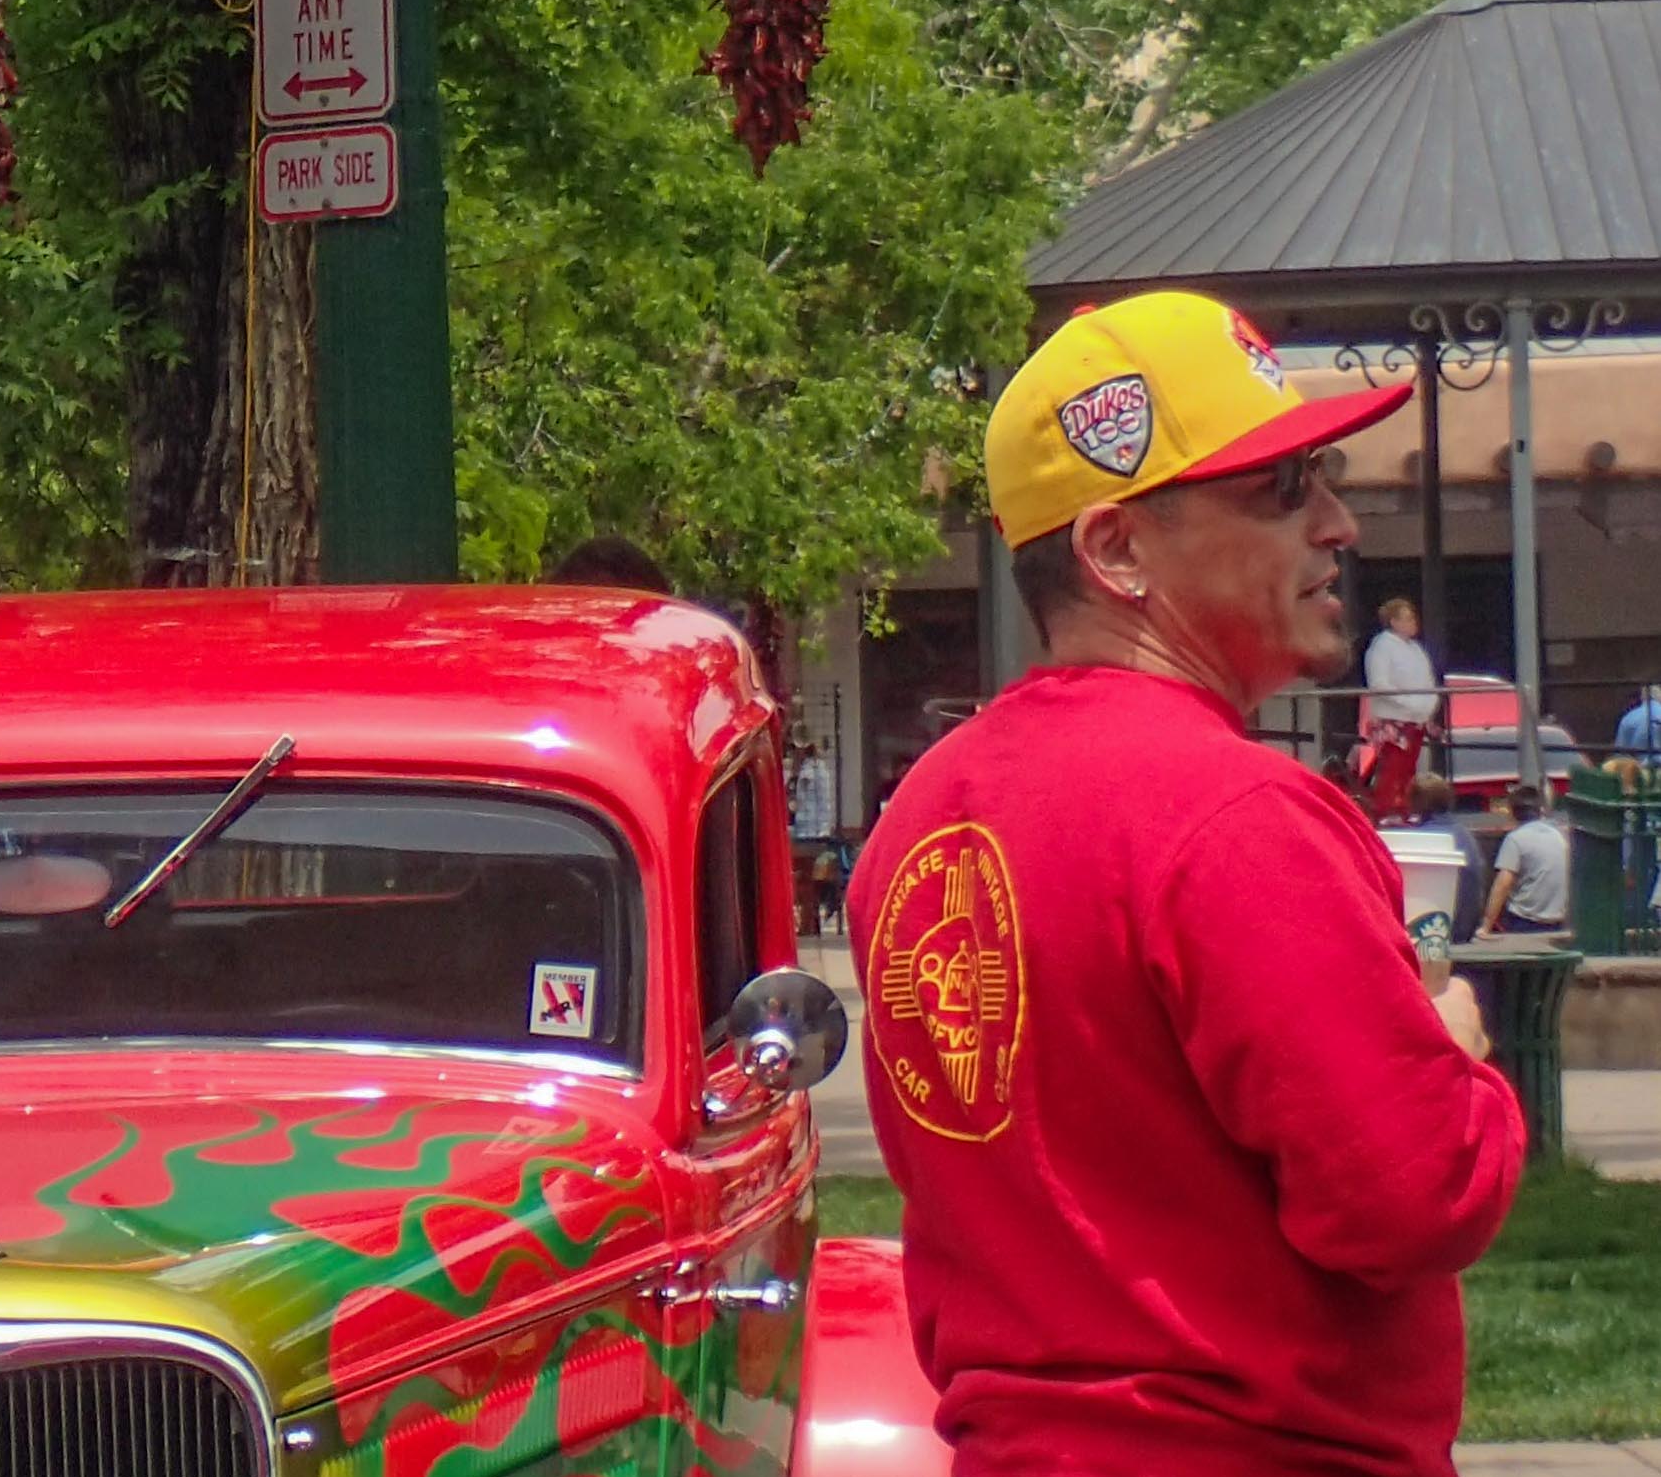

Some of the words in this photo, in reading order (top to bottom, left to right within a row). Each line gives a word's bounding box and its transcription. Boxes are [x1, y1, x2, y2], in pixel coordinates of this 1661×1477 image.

[293, 28, 354, 64] TIME
[278, 157, 323, 192] PARK
[333, 151, 376, 187] SIDE
[1061, 380, 1146, 440] Dukes
[1082, 410, 1140, 451] 100
[883, 873, 919, 950] SANTA
[918, 848, 944, 879] FE
[896, 1057, 930, 1103] CAR
